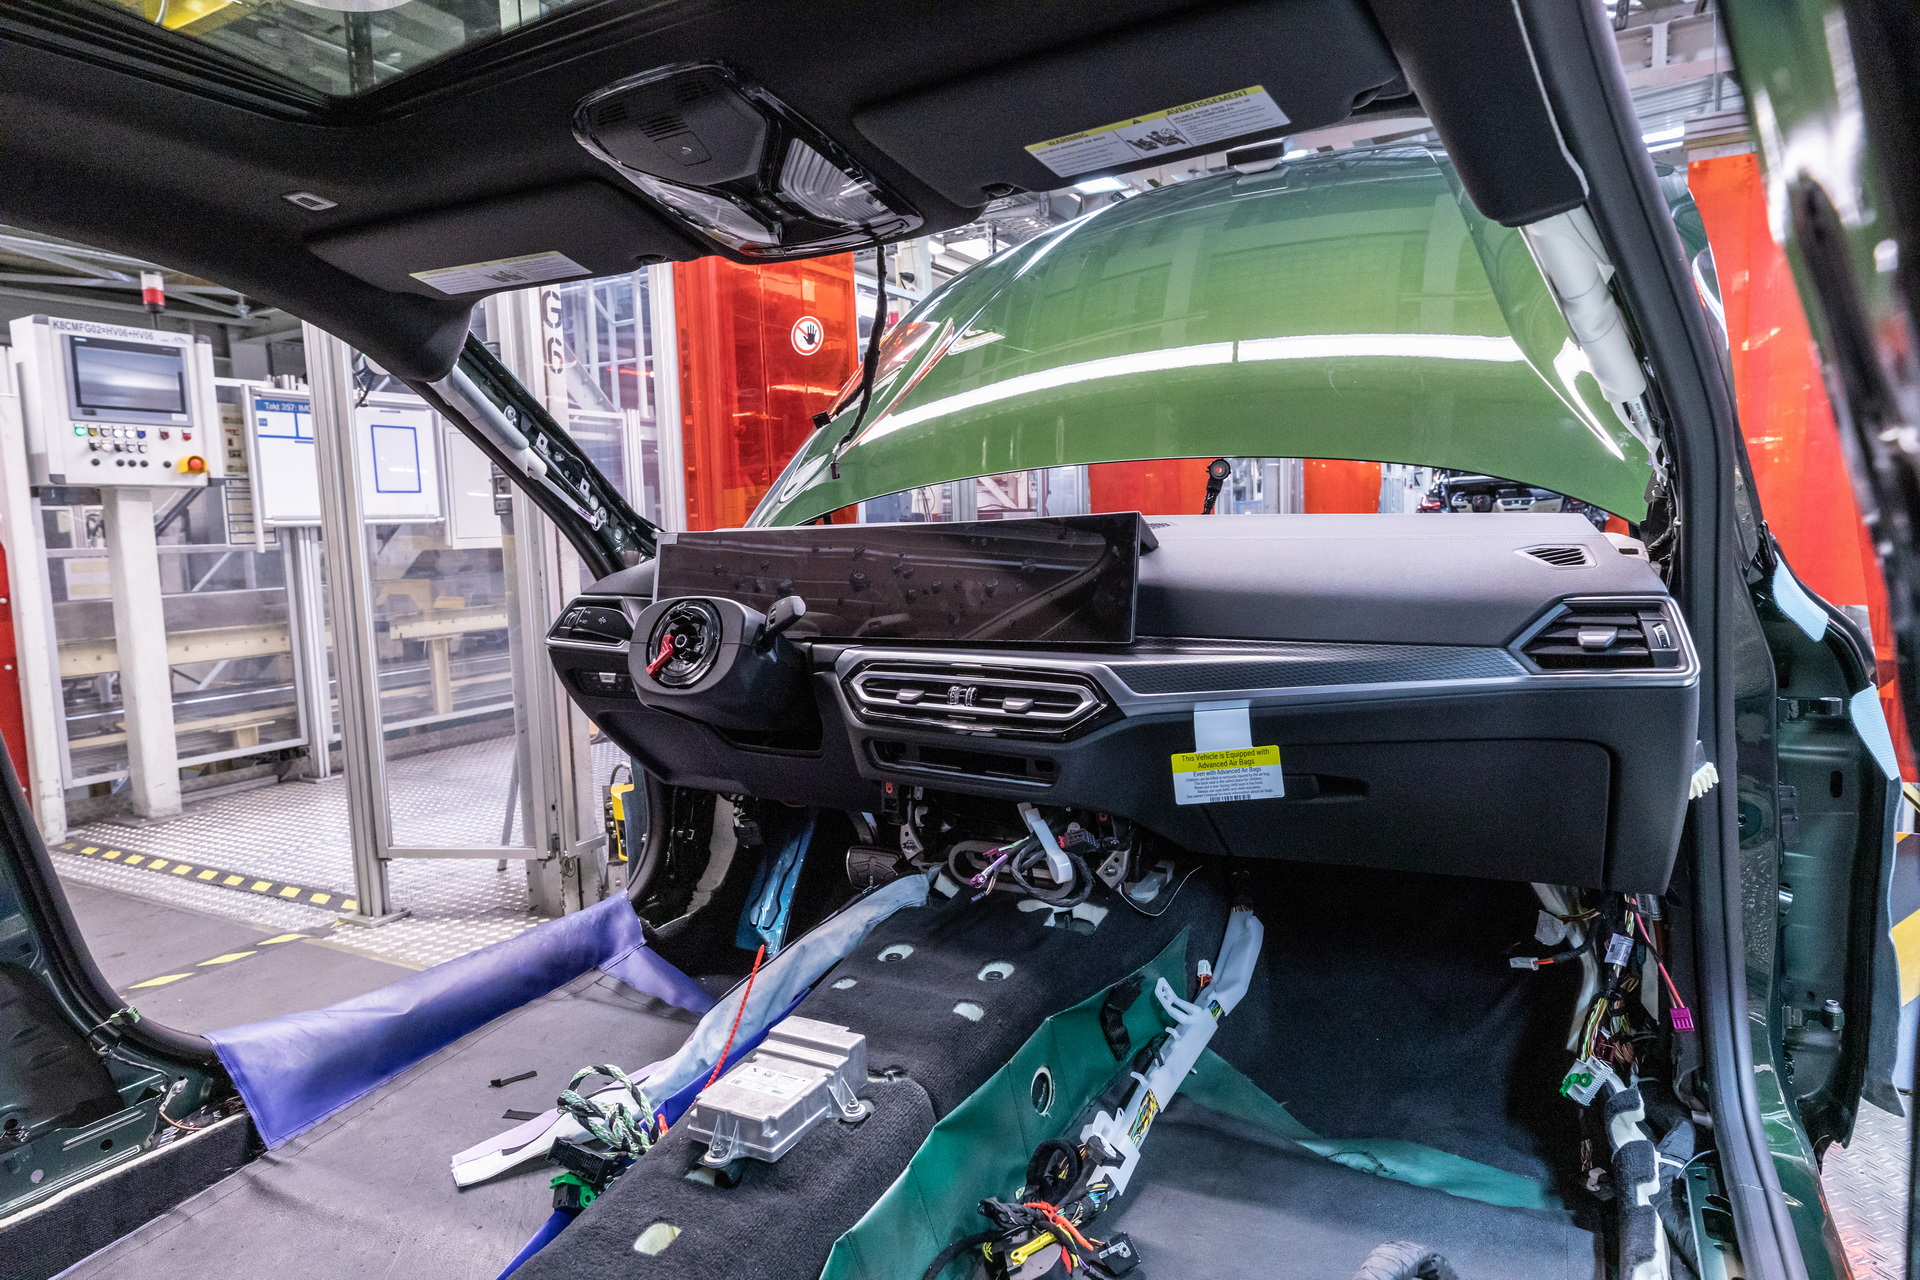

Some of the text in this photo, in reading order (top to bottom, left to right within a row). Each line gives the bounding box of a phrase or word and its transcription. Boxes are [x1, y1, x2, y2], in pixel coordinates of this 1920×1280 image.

[1166, 90, 1248, 116] AVERTISSEMENT
[1046, 132, 1089, 147] WARNING
[52, 320, 154, 340] K8CMFG02=HV06+HV06
[281, 402, 298, 412] 357:
[1226, 750, 1255, 758] Equipped
